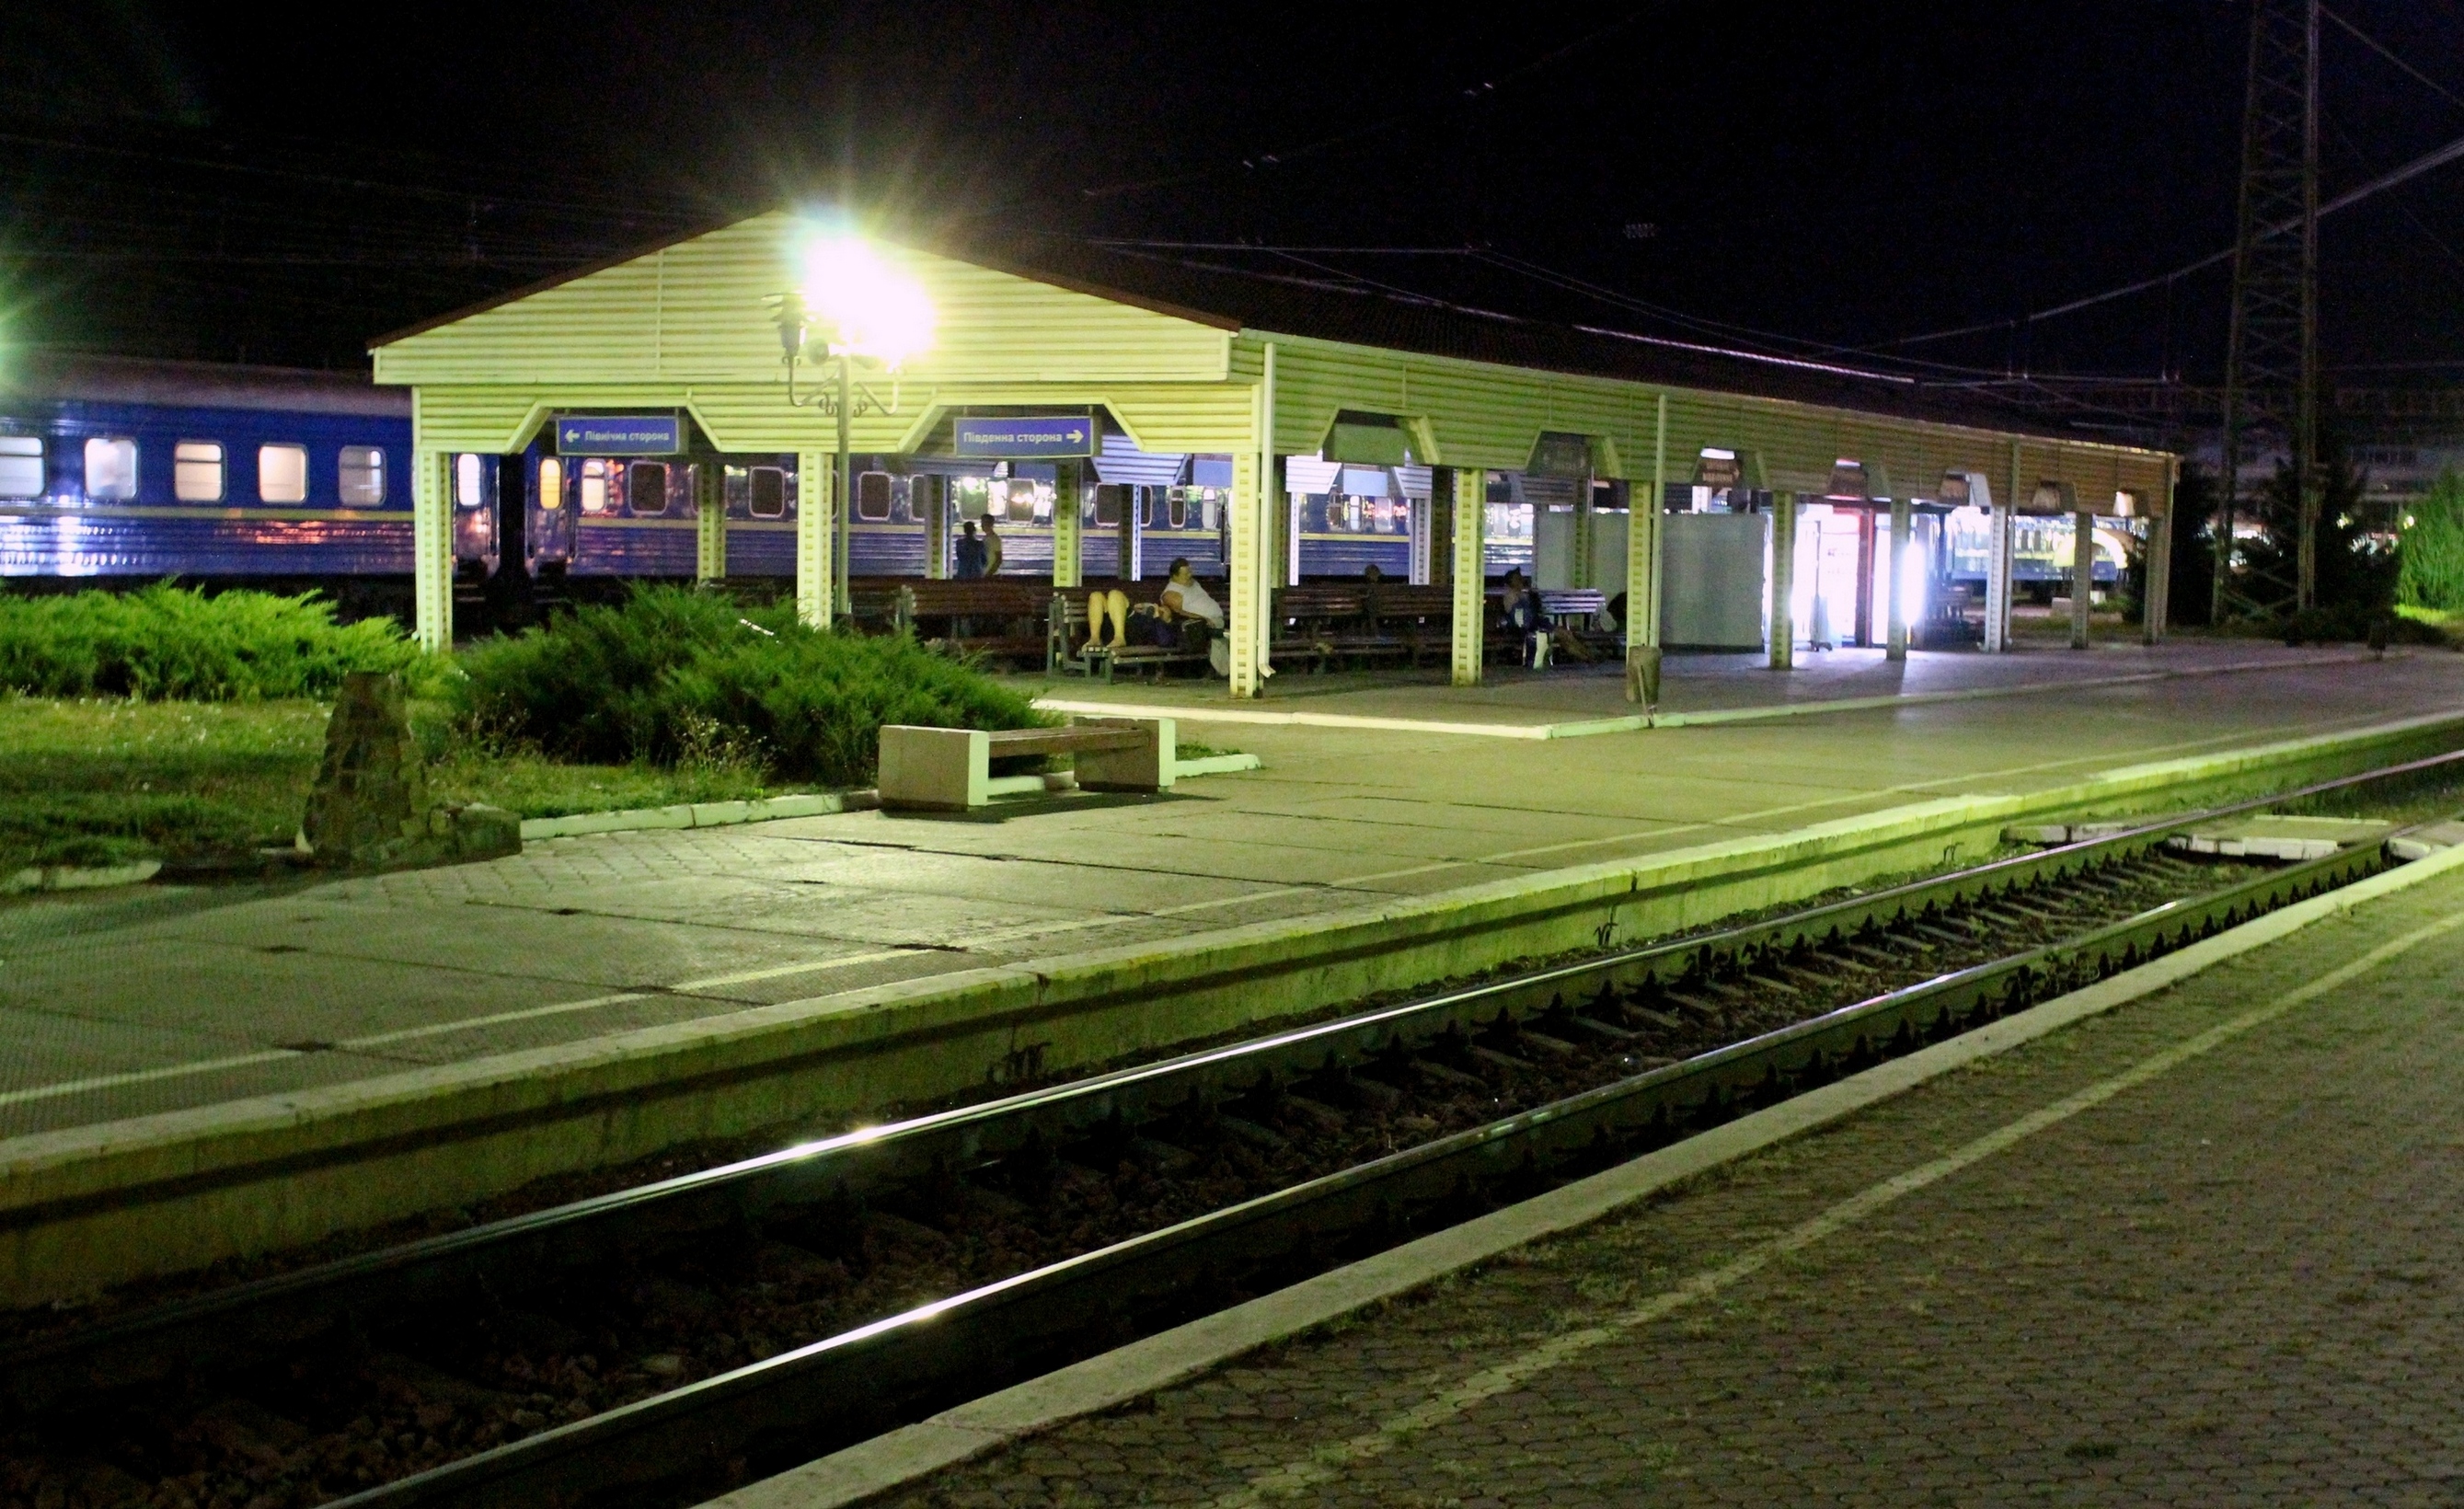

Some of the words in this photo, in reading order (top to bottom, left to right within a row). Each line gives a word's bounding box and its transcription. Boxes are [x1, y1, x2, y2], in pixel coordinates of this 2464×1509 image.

[585, 431, 627, 441] Північна
[628, 432, 670, 443] сторона
[963, 432, 1014, 443] Південна
[1017, 433, 1062, 443] сторона
